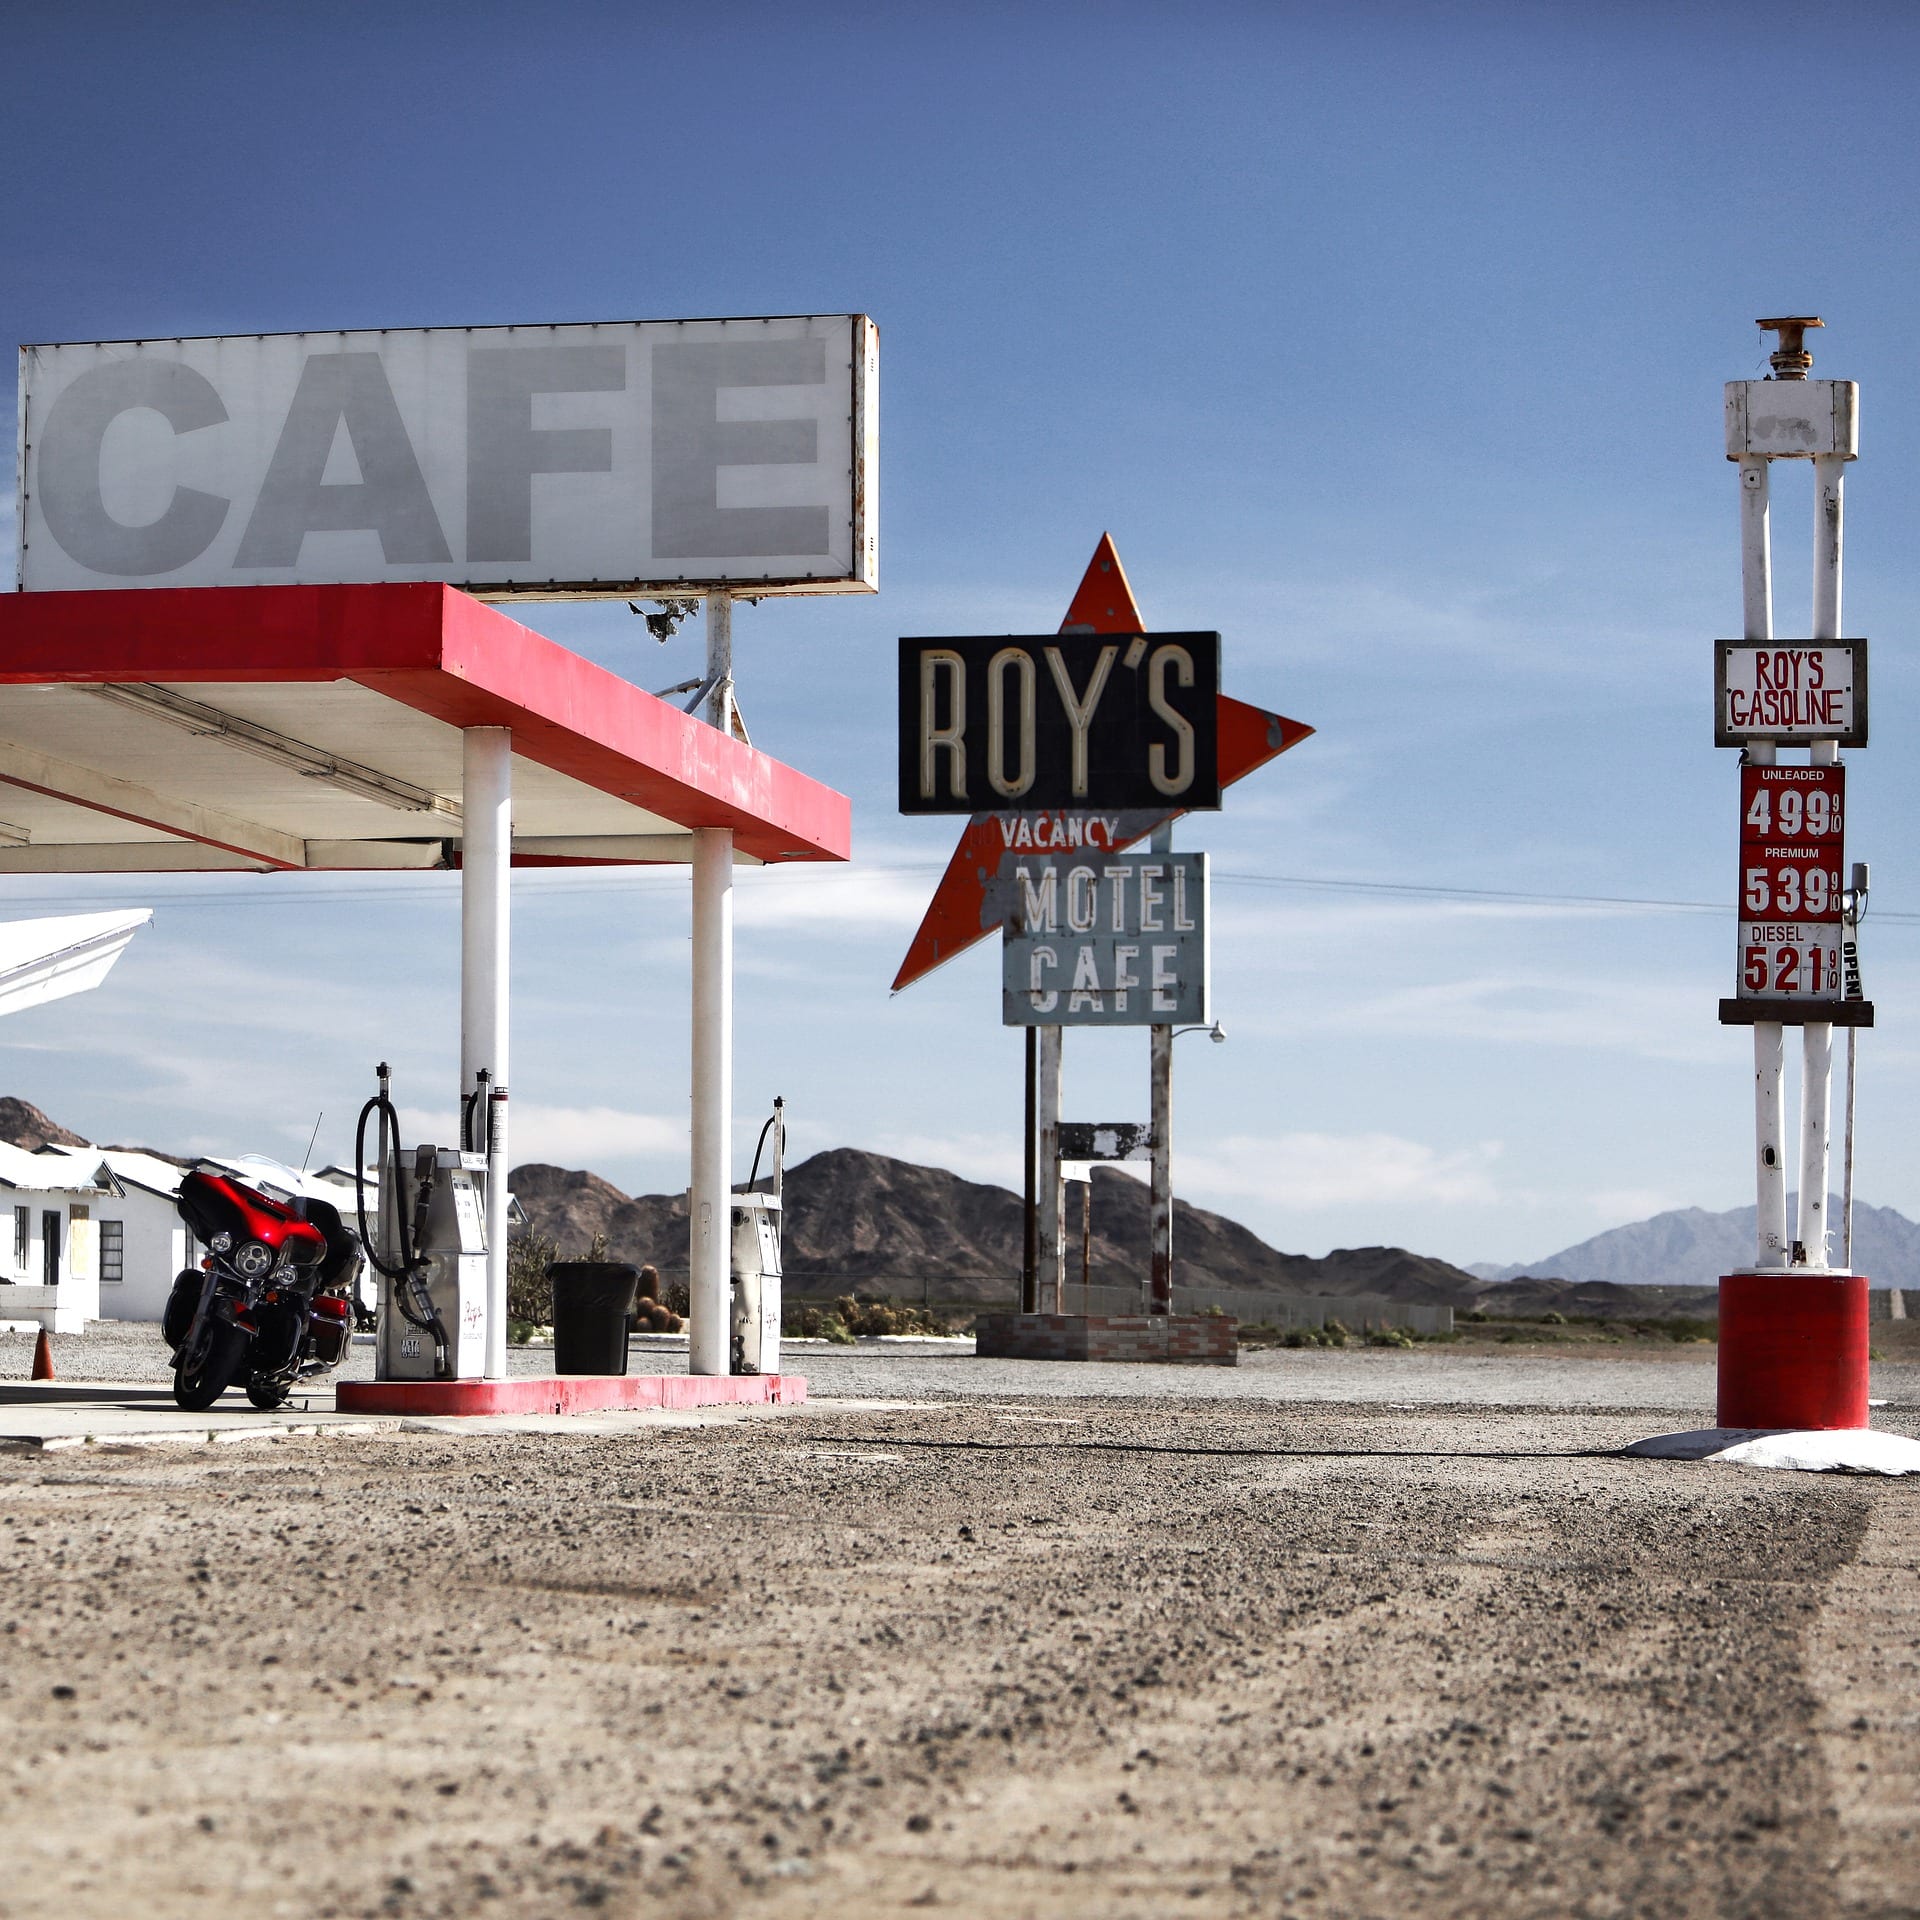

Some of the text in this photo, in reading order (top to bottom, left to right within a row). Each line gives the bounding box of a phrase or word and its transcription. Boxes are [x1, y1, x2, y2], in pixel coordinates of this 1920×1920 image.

[37, 337, 830, 577] CAFE
[1755, 650, 1824, 690] ROY'S
[919, 635, 1196, 799] ROY'S
[1730, 689, 1844, 727] GASOLINE
[1762, 770, 1825, 781] UNLEADED
[1000, 816, 1120, 848] VACANCY
[1765, 847, 1819, 859] PREMIUM
[1015, 865, 1196, 934] MOTEL
[1751, 926, 1805, 942] DIESEL
[1029, 945, 1179, 1014] CAFE
[1843, 941, 1861, 995] OPEN
